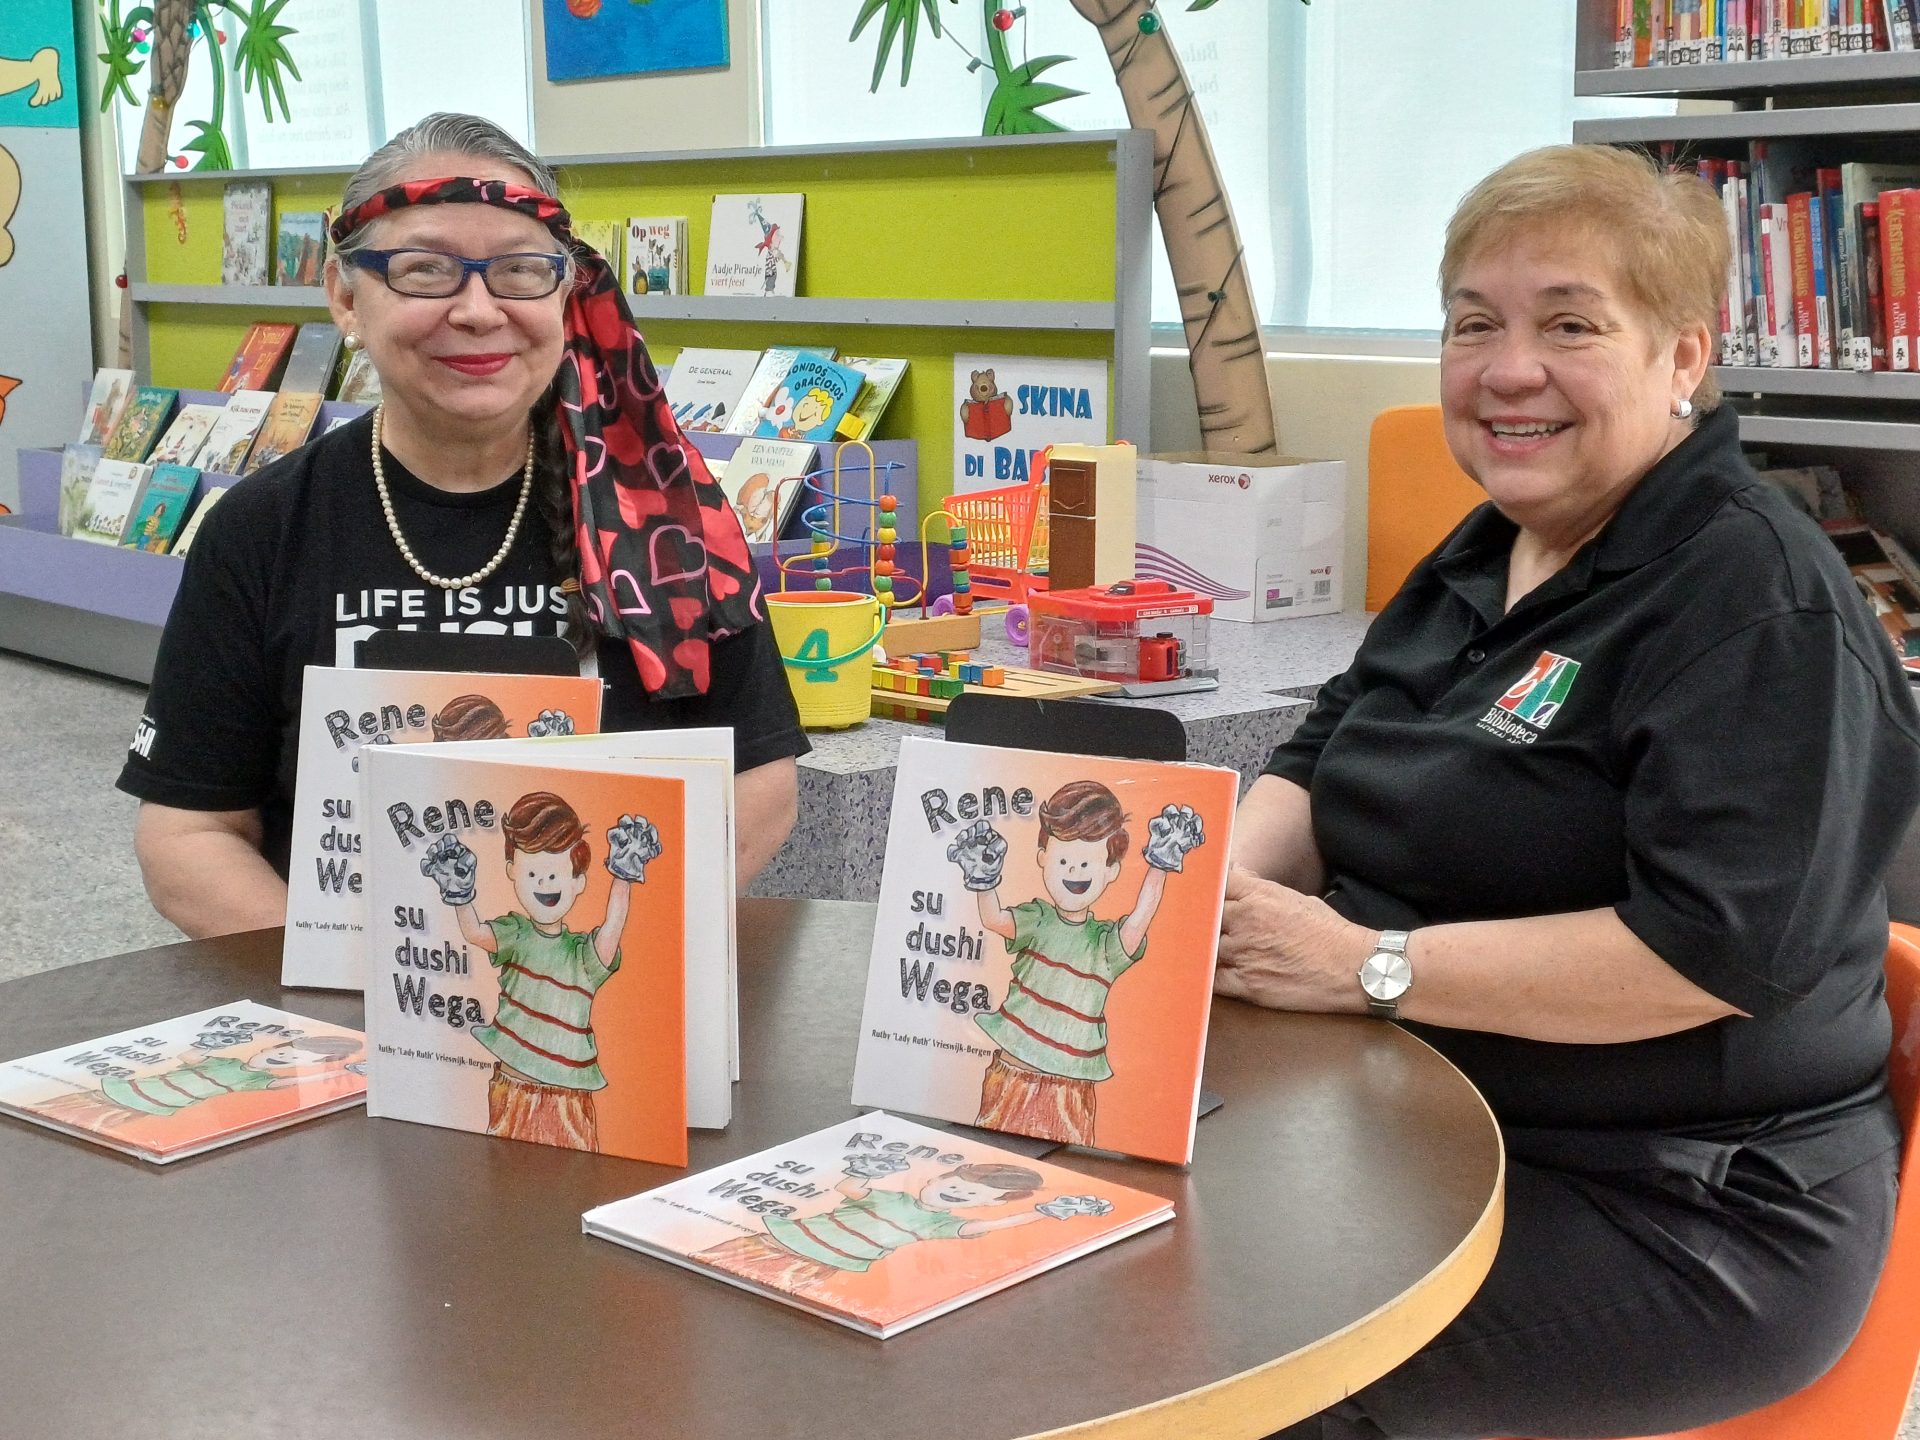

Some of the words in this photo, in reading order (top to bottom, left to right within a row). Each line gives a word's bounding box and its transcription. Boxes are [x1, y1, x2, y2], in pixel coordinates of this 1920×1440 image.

[631, 225, 646, 242] Op
[648, 224, 670, 239] weg
[711, 263, 733, 278] Aadje
[733, 264, 763, 278] Piraatje
[728, 277, 745, 289] feest
[688, 366, 699, 374] DE
[699, 367, 733, 377] GENERAAL
[1017, 384, 1093, 419] SKINA
[964, 453, 984, 477] DI
[1208, 473, 1236, 485] xerox
[335, 588, 426, 622] LIFE
[444, 586, 482, 617] IS
[492, 584, 570, 617] JUS
[795, 628, 839, 683] 4
[324, 702, 427, 749] Rene
[1478, 707, 1539, 744] Biblioteca
[322, 798, 352, 821] su
[386, 797, 494, 848] Rene
[920, 785, 1034, 833] Rene
[319, 825, 361, 854] dus
[315, 857, 362, 895] We
[910, 889, 943, 916] su
[394, 905, 425, 931] su
[394, 937, 469, 975] dushi
[905, 922, 984, 962] dushi
[392, 972, 485, 1029] Wega
[899, 957, 991, 1014] Wega
[204, 1014, 306, 1039] Rene
[104, 1043, 172, 1066] dushi
[133, 1035, 168, 1049] su
[64, 1050, 137, 1080] Wega
[844, 1131, 967, 1166] Rene
[775, 1158, 812, 1175] su
[707, 1178, 798, 1219] Wega
[745, 1169, 831, 1200] dushi
